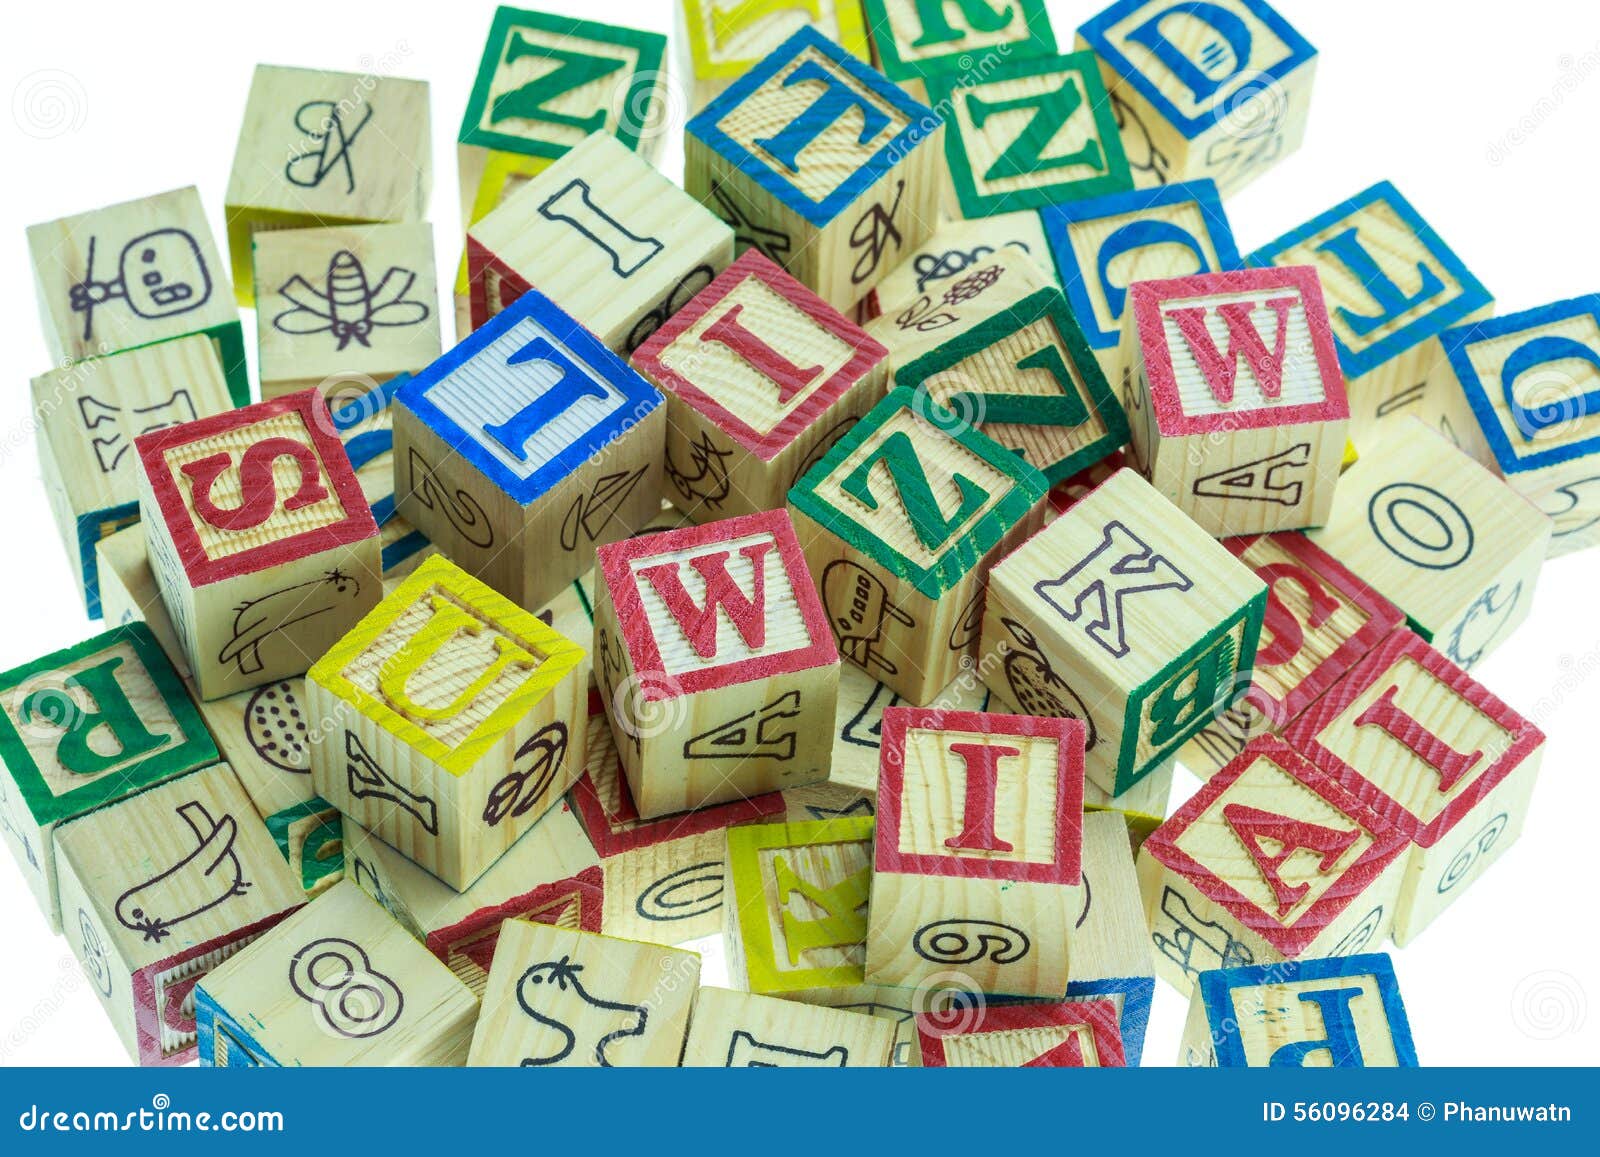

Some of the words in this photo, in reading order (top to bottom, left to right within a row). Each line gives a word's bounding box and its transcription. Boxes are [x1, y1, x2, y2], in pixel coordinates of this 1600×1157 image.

[1125, 1, 1252, 104] D
[752, 59, 892, 173] T
[537, 178, 664, 279] I
[700, 304, 825, 405] I
[1165, 295, 1300, 405] W
[180, 437, 329, 531] S
[840, 430, 990, 551] Z
[1193, 442, 1310, 507] A
[637, 541, 773, 660] W
[1034, 519, 1194, 659] K
[378, 594, 535, 720] U
[1150, 633, 1236, 747] B
[22, 655, 171, 774] R
[683, 690, 800, 760] A
[1353, 684, 1484, 792] I
[346, 729, 438, 835] Y
[944, 742, 1020, 852] I
[1222, 802, 1363, 918] A
[289, 937, 404, 1038] 8
